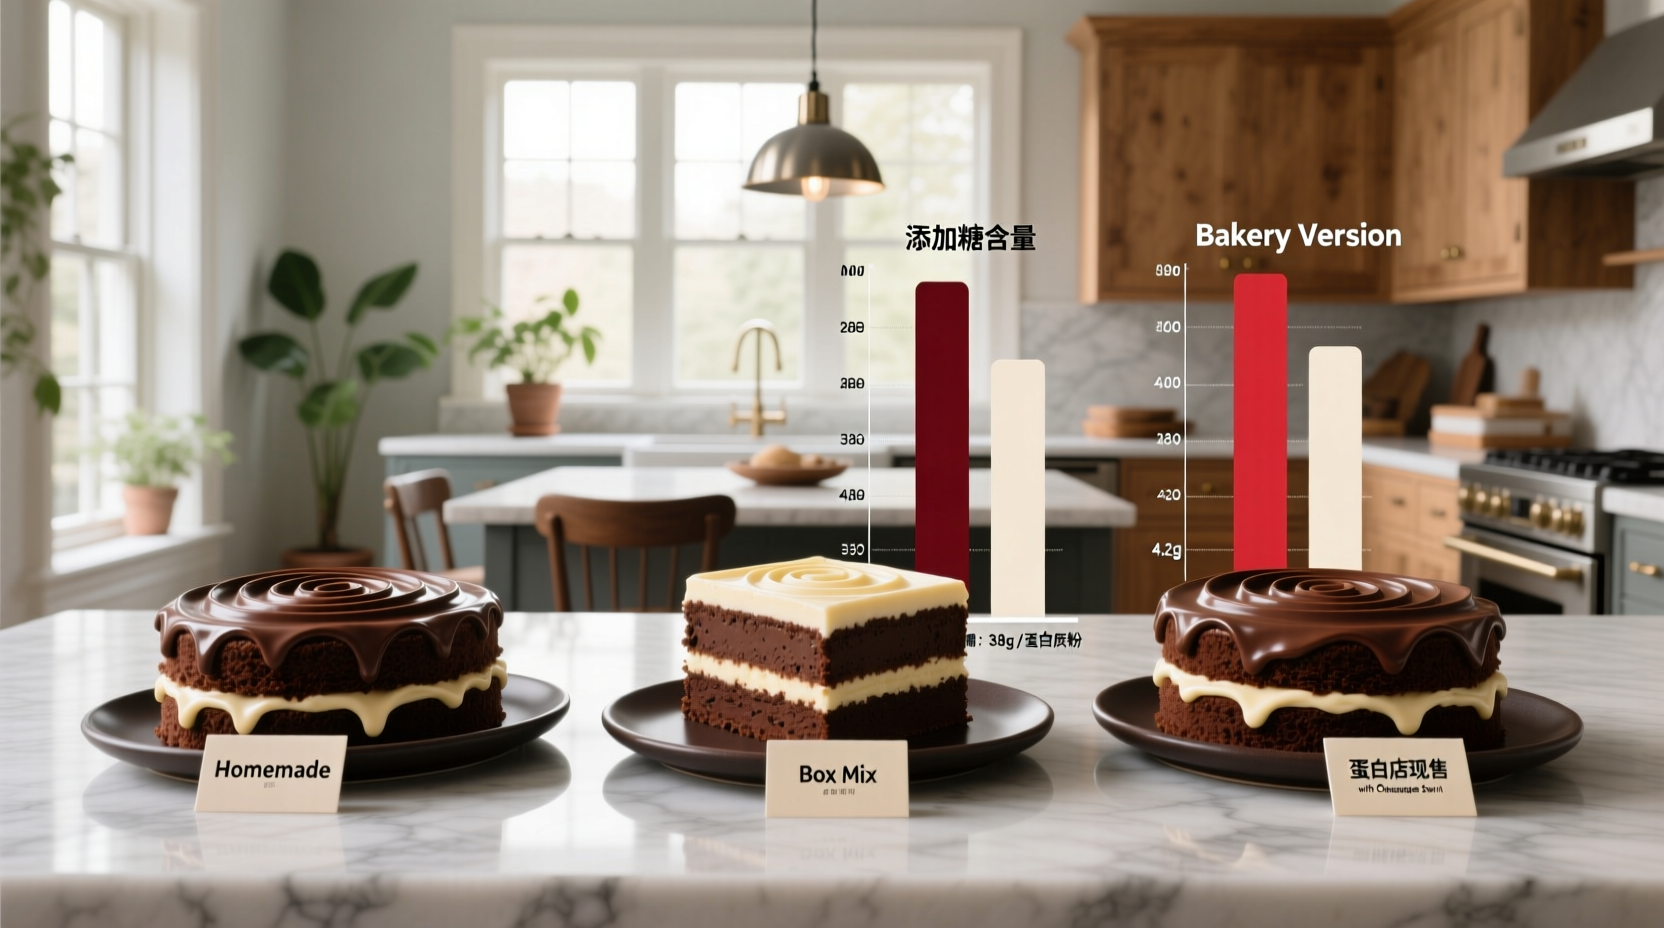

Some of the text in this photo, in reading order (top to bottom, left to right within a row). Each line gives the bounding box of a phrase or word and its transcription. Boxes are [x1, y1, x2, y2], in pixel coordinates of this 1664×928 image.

[215, 759, 331, 779] Homemade
[799, 763, 877, 784] Box Mix
[1348, 757, 1448, 780] 蛋白店现售
